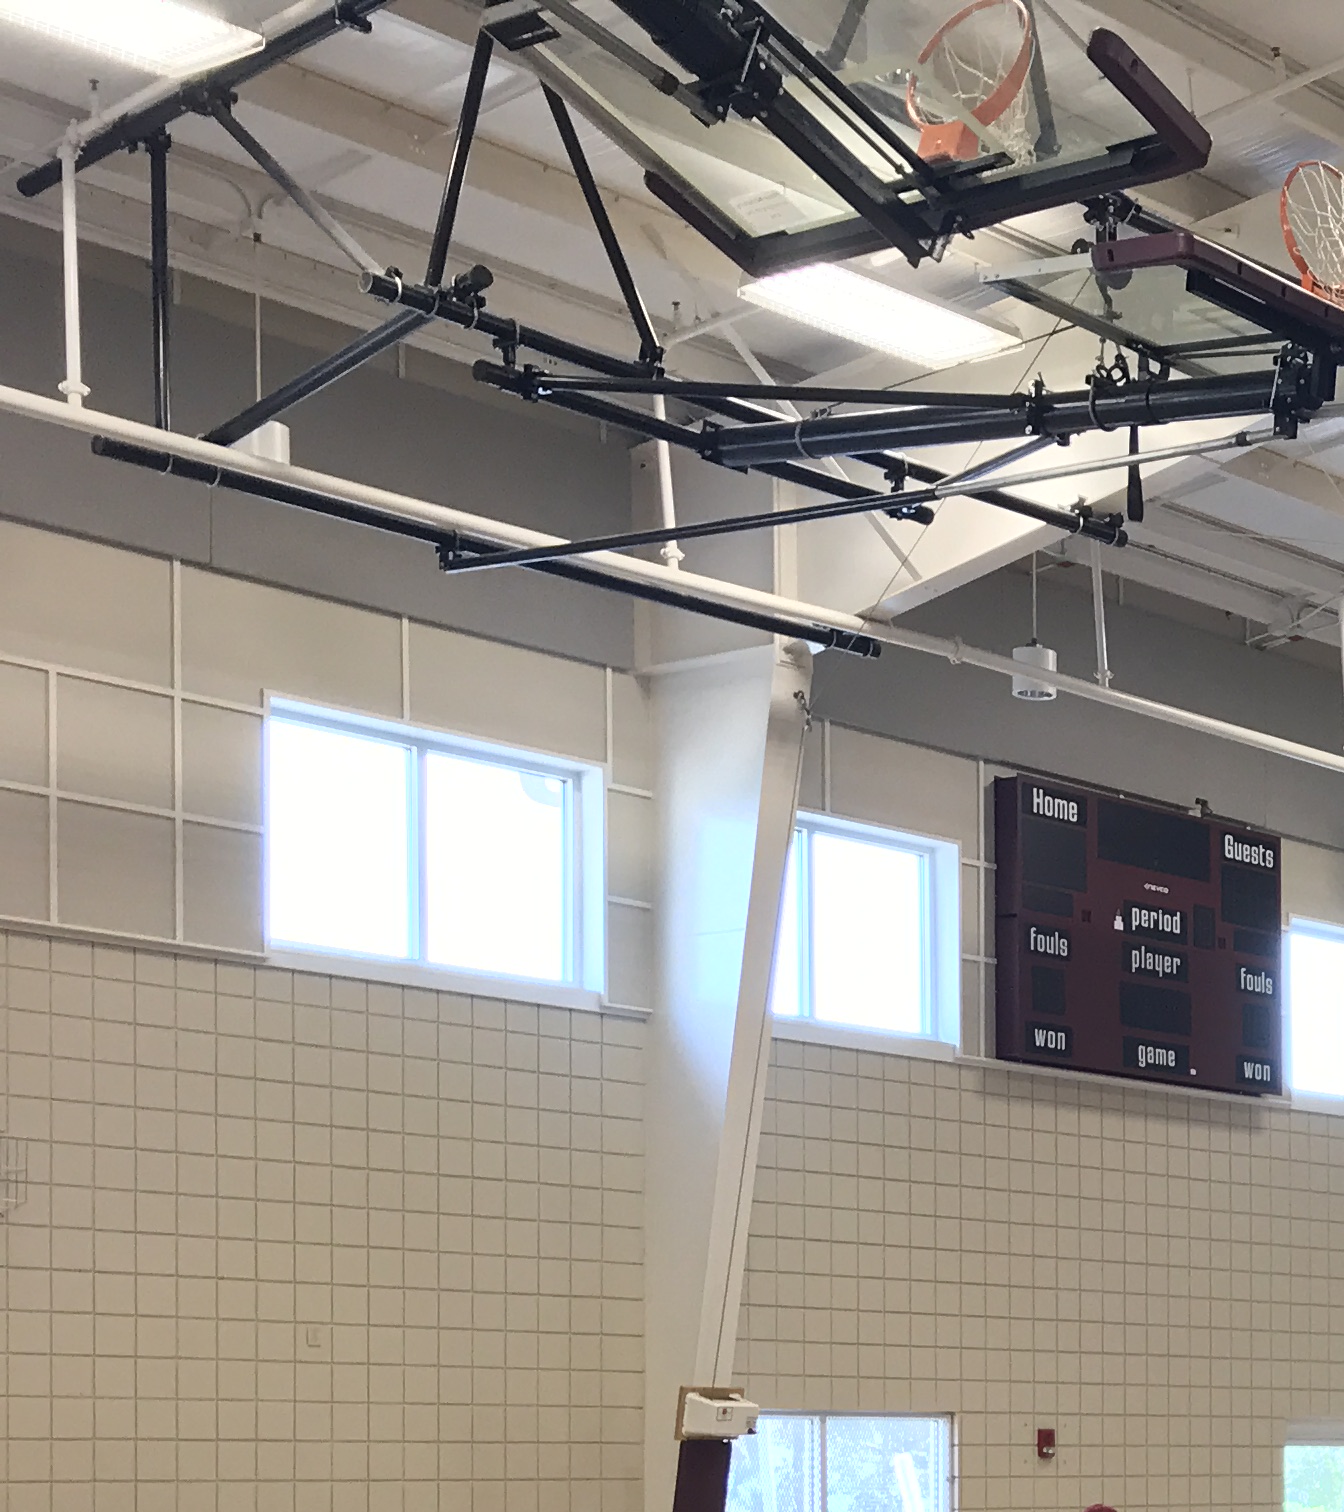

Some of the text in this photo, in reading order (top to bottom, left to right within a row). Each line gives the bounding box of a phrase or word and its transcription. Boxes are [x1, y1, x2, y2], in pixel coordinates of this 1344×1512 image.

[1032, 787, 1078, 822] Home
[1224, 835, 1274, 869] Guests
[1131, 906, 1181, 934] period
[1030, 927, 1068, 957] fouls
[1131, 946, 1181, 977] player
[1240, 967, 1273, 995] fouls
[1034, 1028, 1066, 1051] won
[1138, 1045, 1176, 1068] game
[1243, 1061, 1271, 1082] won
